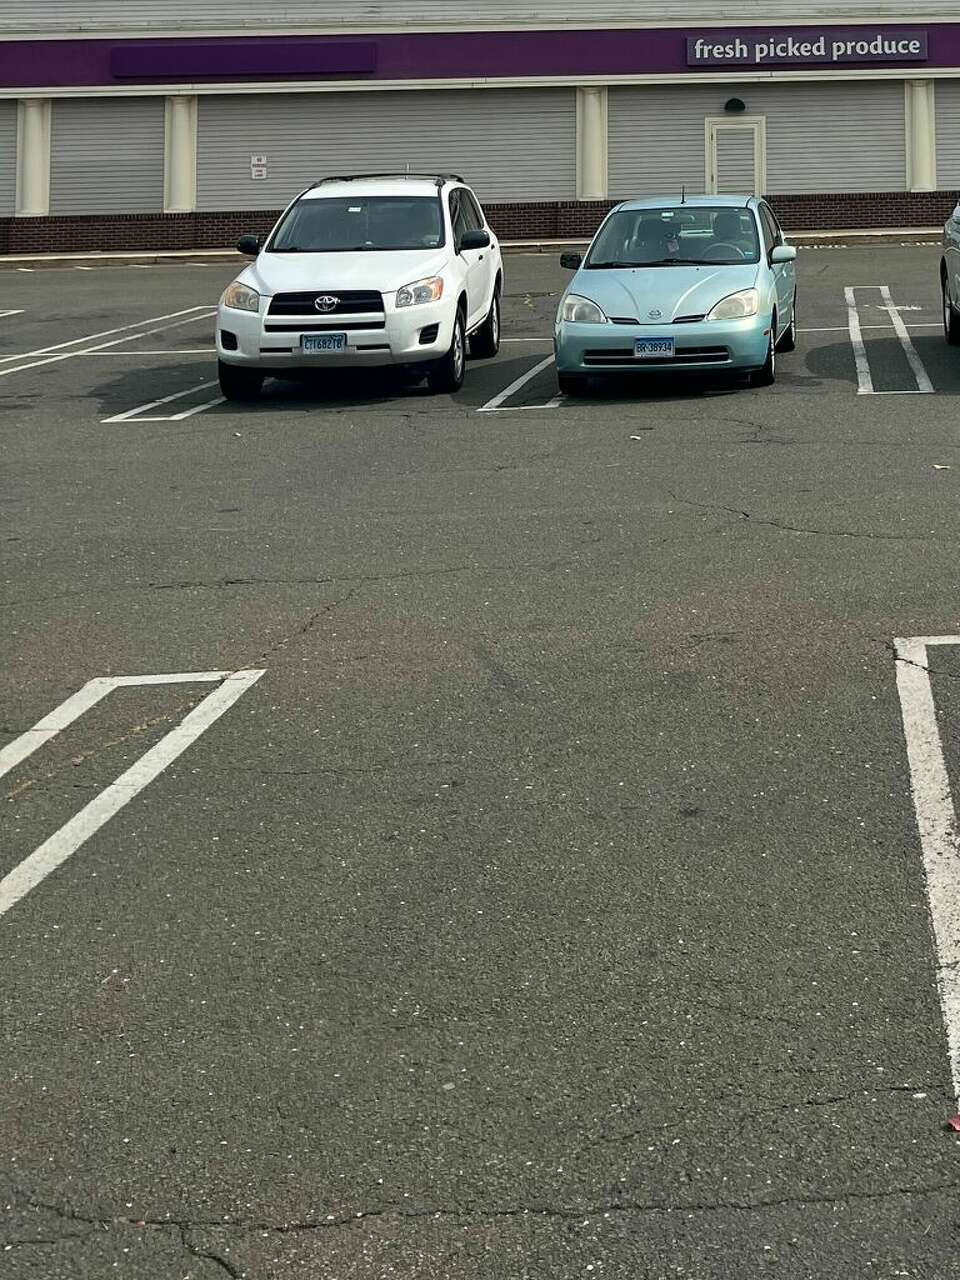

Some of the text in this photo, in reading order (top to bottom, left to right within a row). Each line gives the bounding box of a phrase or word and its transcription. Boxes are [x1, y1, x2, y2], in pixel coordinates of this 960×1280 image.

[695, 35, 921, 62] fresh picked produce
